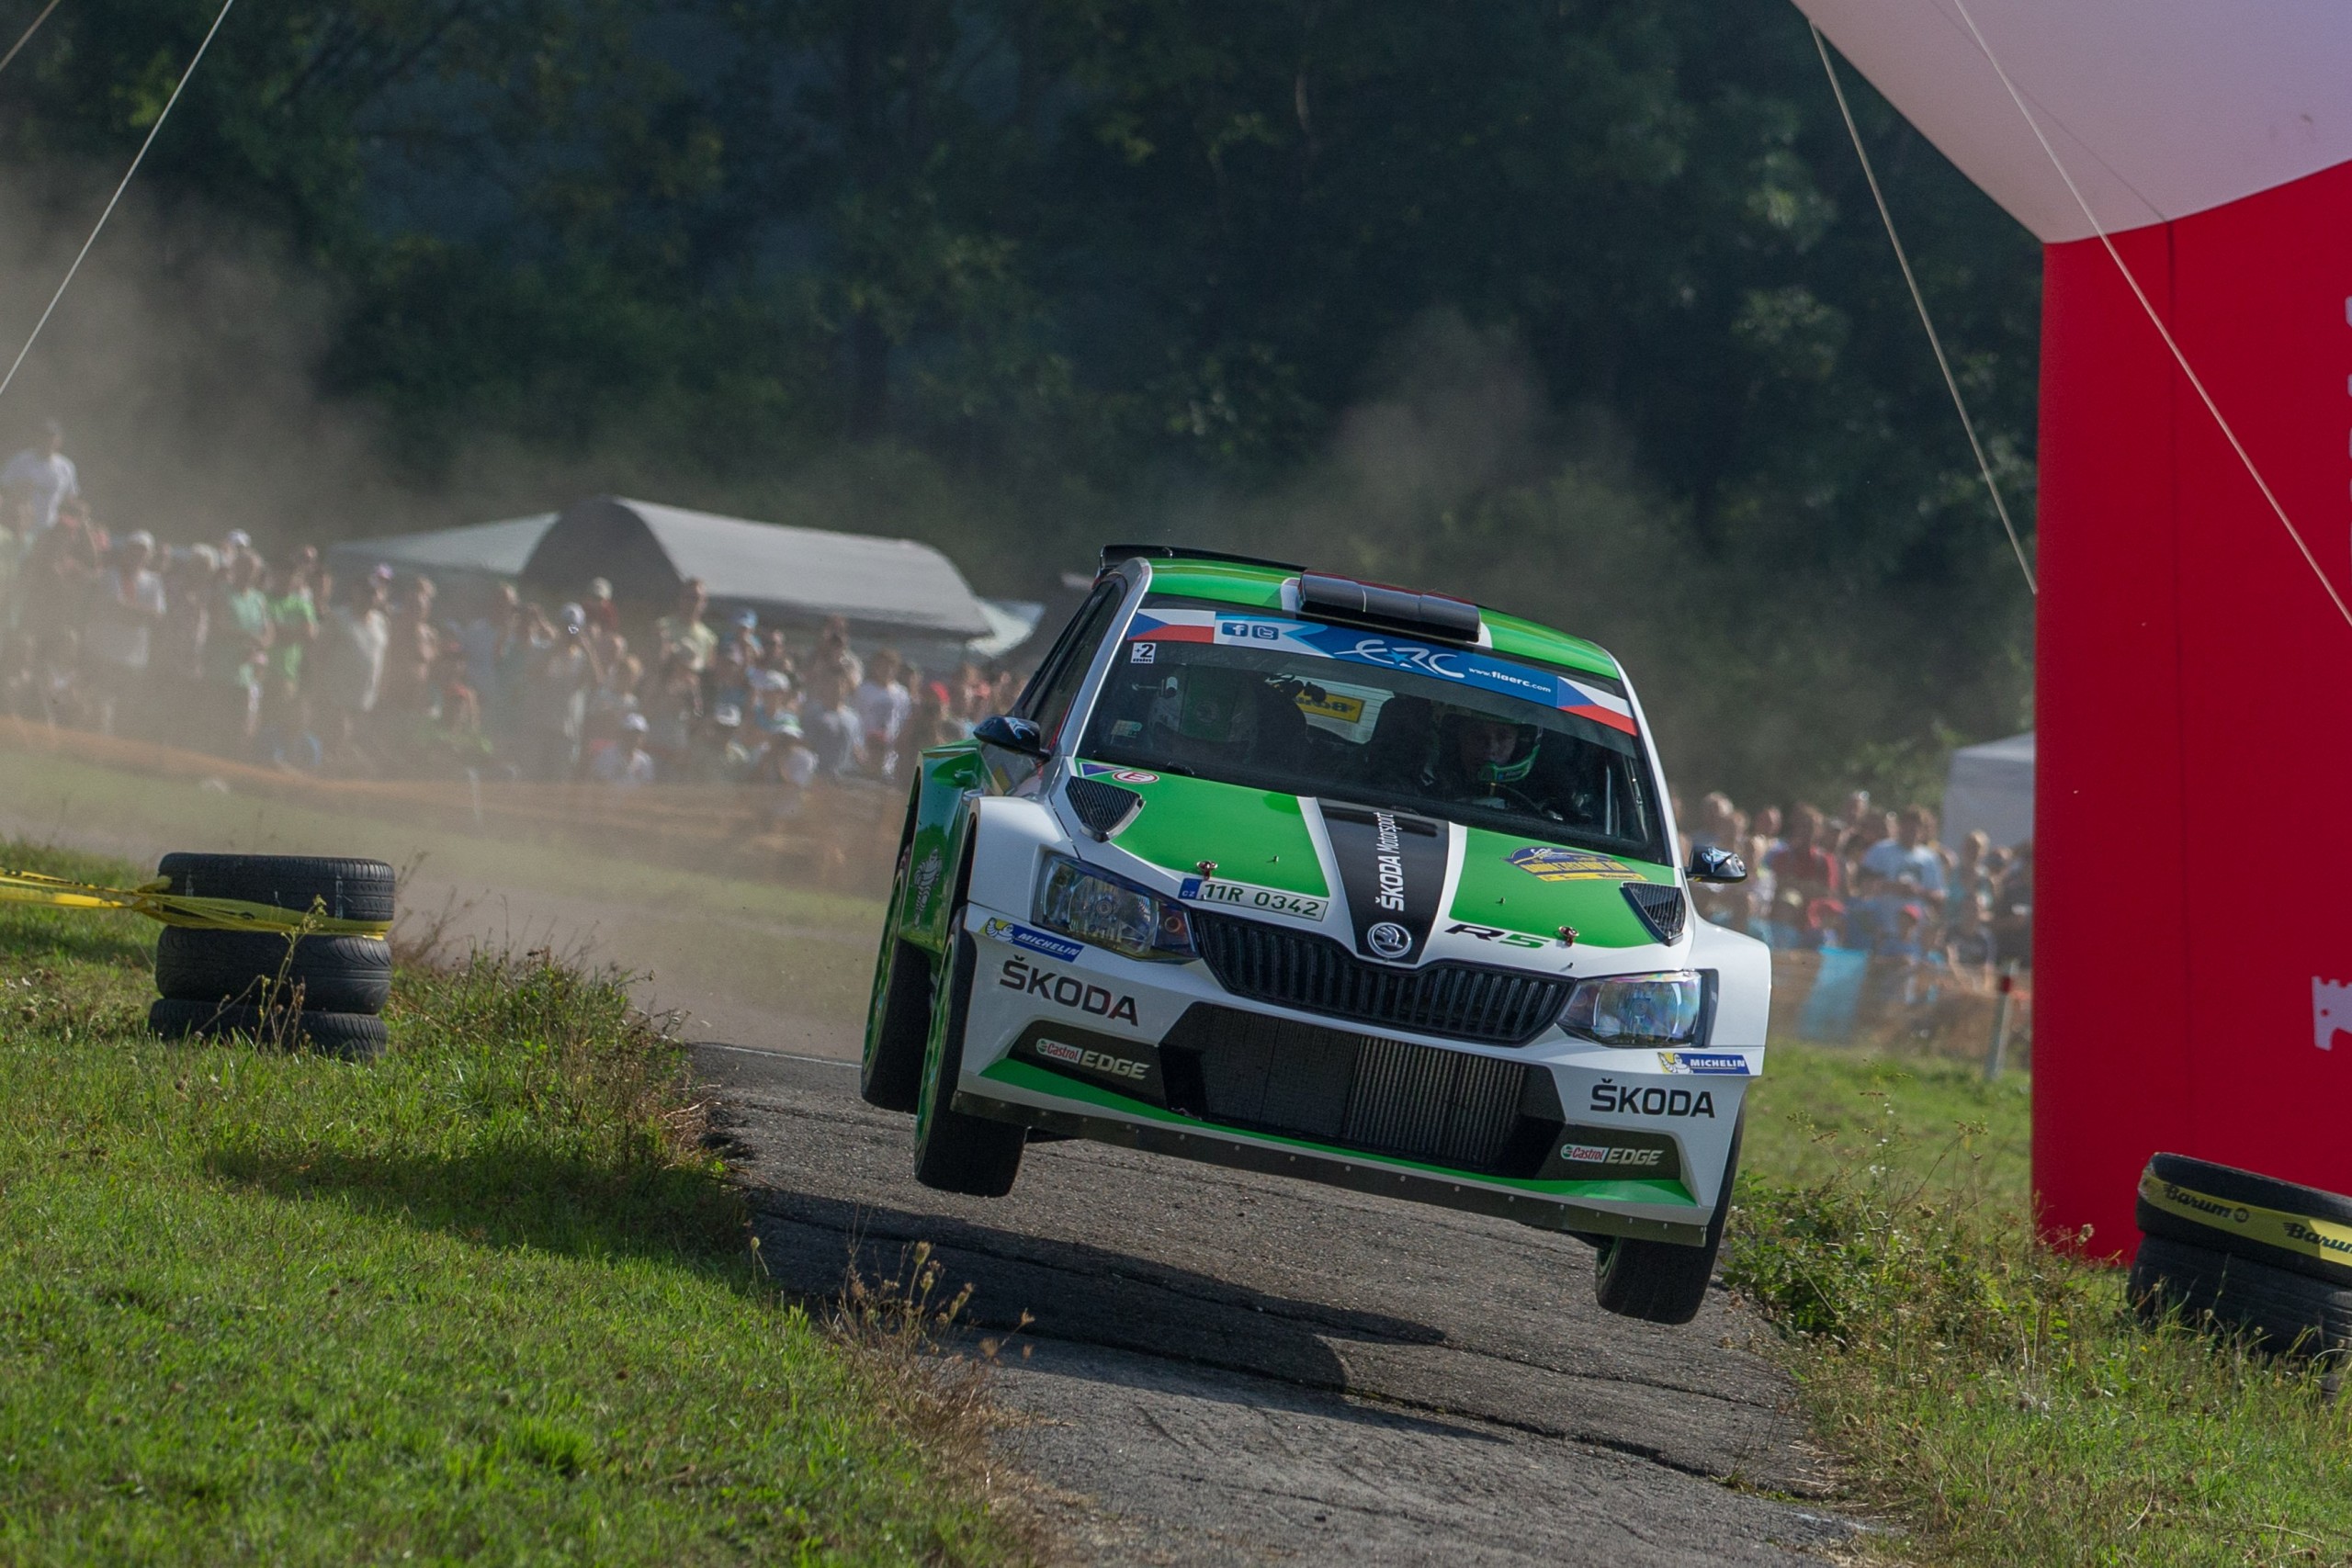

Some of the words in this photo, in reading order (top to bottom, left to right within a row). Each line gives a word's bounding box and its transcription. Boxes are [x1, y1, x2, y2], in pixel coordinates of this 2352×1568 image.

[1334, 638, 1465, 679] ERC
[1468, 667, 1552, 693] www.fiaerc.com
[1374, 811, 1403, 854] Motorsport
[1204, 883, 1244, 903] 11R
[1254, 891, 1320, 917] 0342
[1374, 855, 1405, 912] ŠKODA
[1017, 932, 1080, 956] MICHELIN
[1443, 923, 1551, 949] R5
[999, 953, 1139, 1028] ŠKODA
[1047, 1043, 1080, 1061] Castrol
[1080, 1050, 1150, 1080] EDGE
[1690, 1058, 1746, 1068] MICHELIN
[1589, 1077, 1716, 1119] ŠKODA
[1572, 1146, 1606, 1161] Castrol
[1605, 1147, 1666, 1166] EDGE
[2163, 1183, 2232, 1218] Barum
